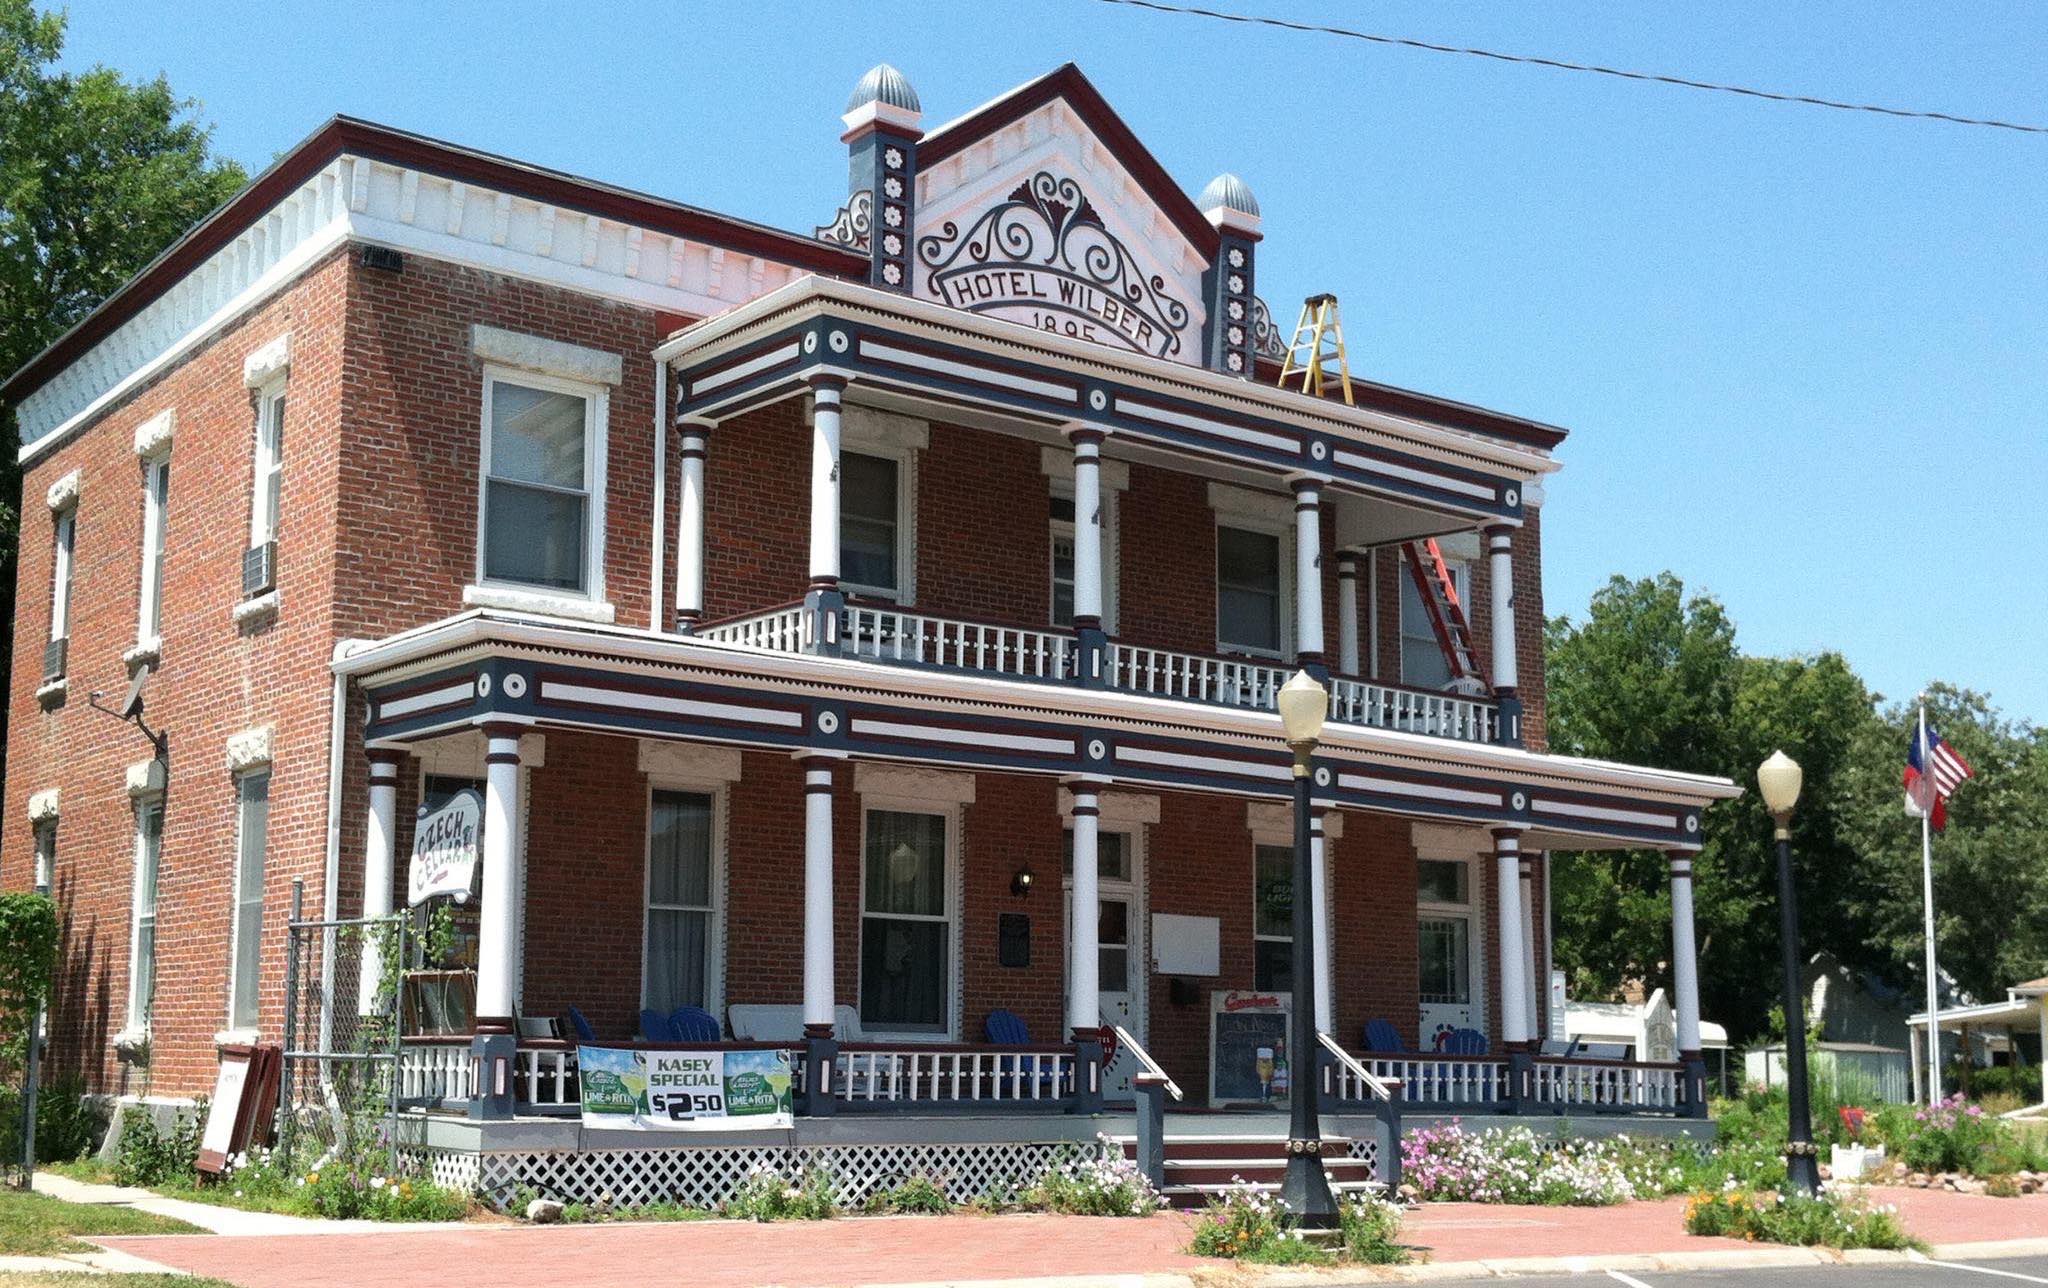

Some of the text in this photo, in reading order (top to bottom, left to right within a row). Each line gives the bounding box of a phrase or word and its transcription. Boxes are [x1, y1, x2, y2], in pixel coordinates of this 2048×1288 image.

[953, 271, 1153, 347] HOTEL WILBER
[1033, 312, 1096, 342] 1895
[418, 811, 464, 861] CZECH
[651, 1074, 719, 1086] SPECIAL
[657, 1059, 713, 1071] KASEY
